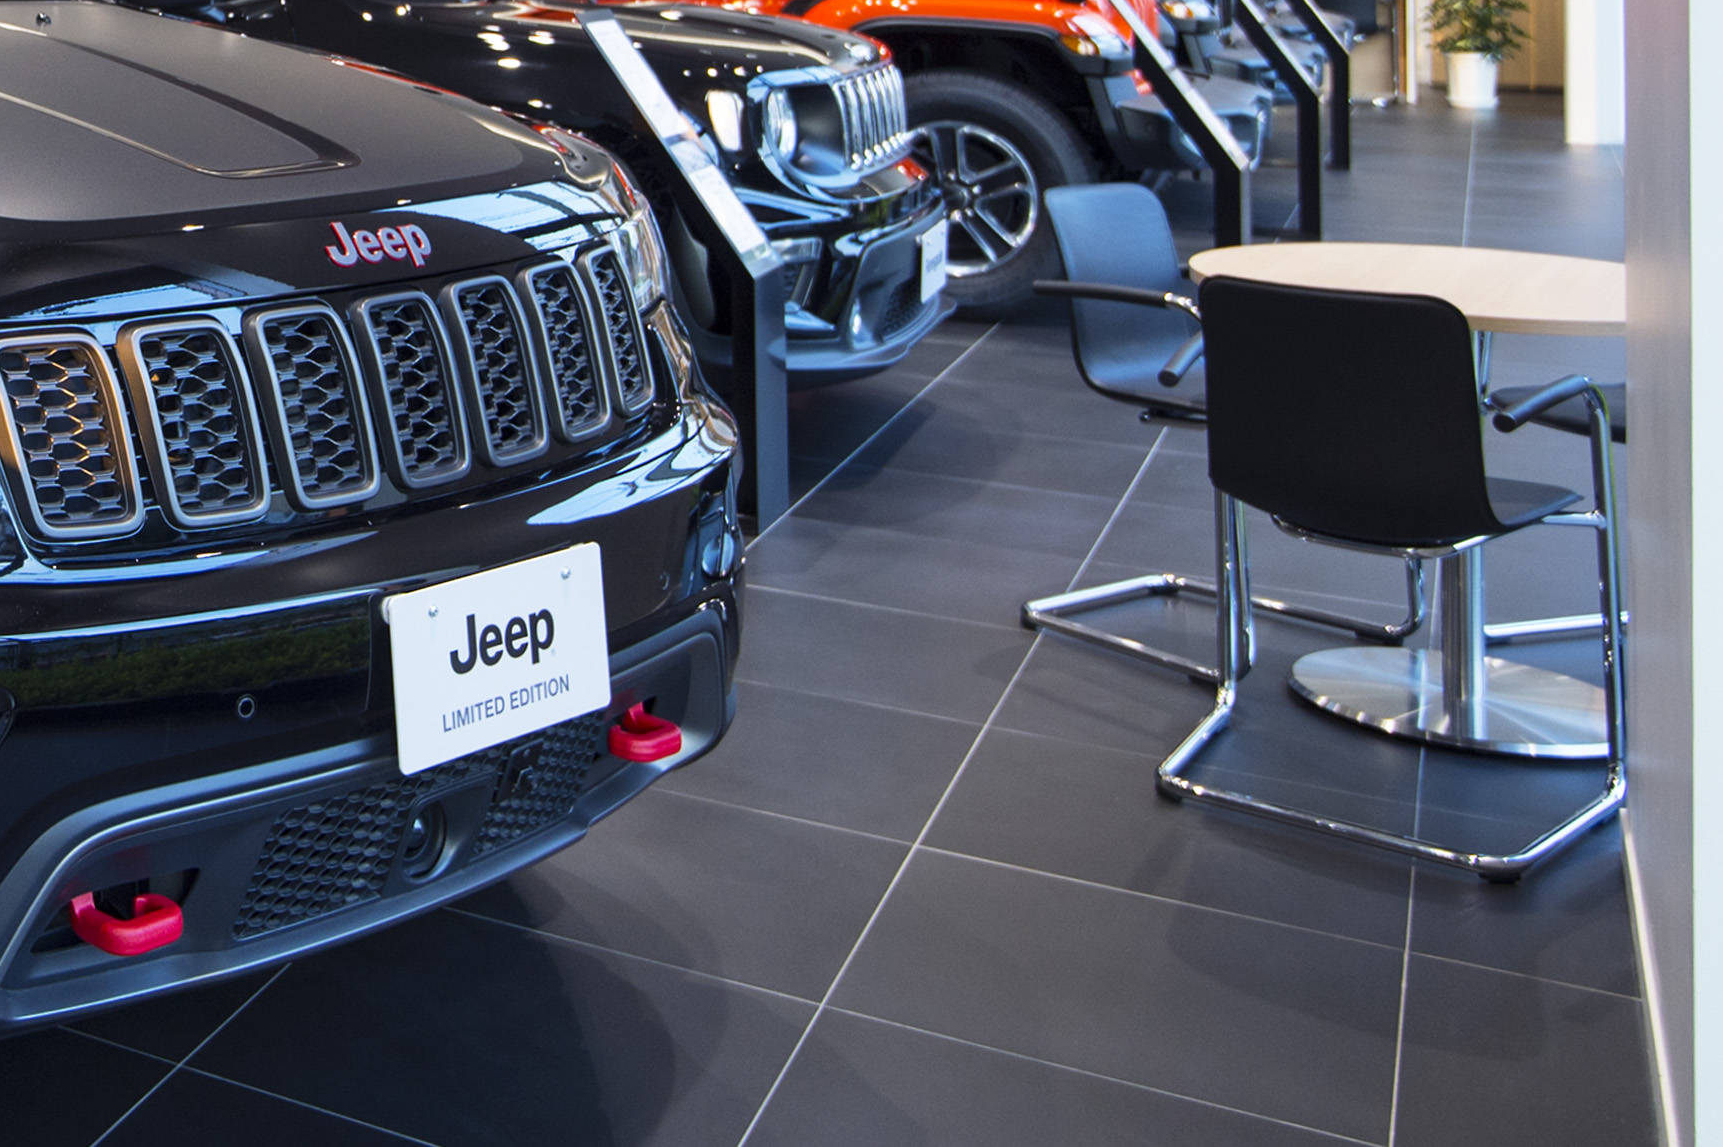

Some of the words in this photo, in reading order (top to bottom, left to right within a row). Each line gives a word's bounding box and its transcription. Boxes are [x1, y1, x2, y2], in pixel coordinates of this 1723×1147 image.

[325, 221, 432, 268] Jeep
[450, 608, 554, 674] Jeep
[442, 696, 506, 733] LIMITED
[510, 673, 570, 711] EDITION
